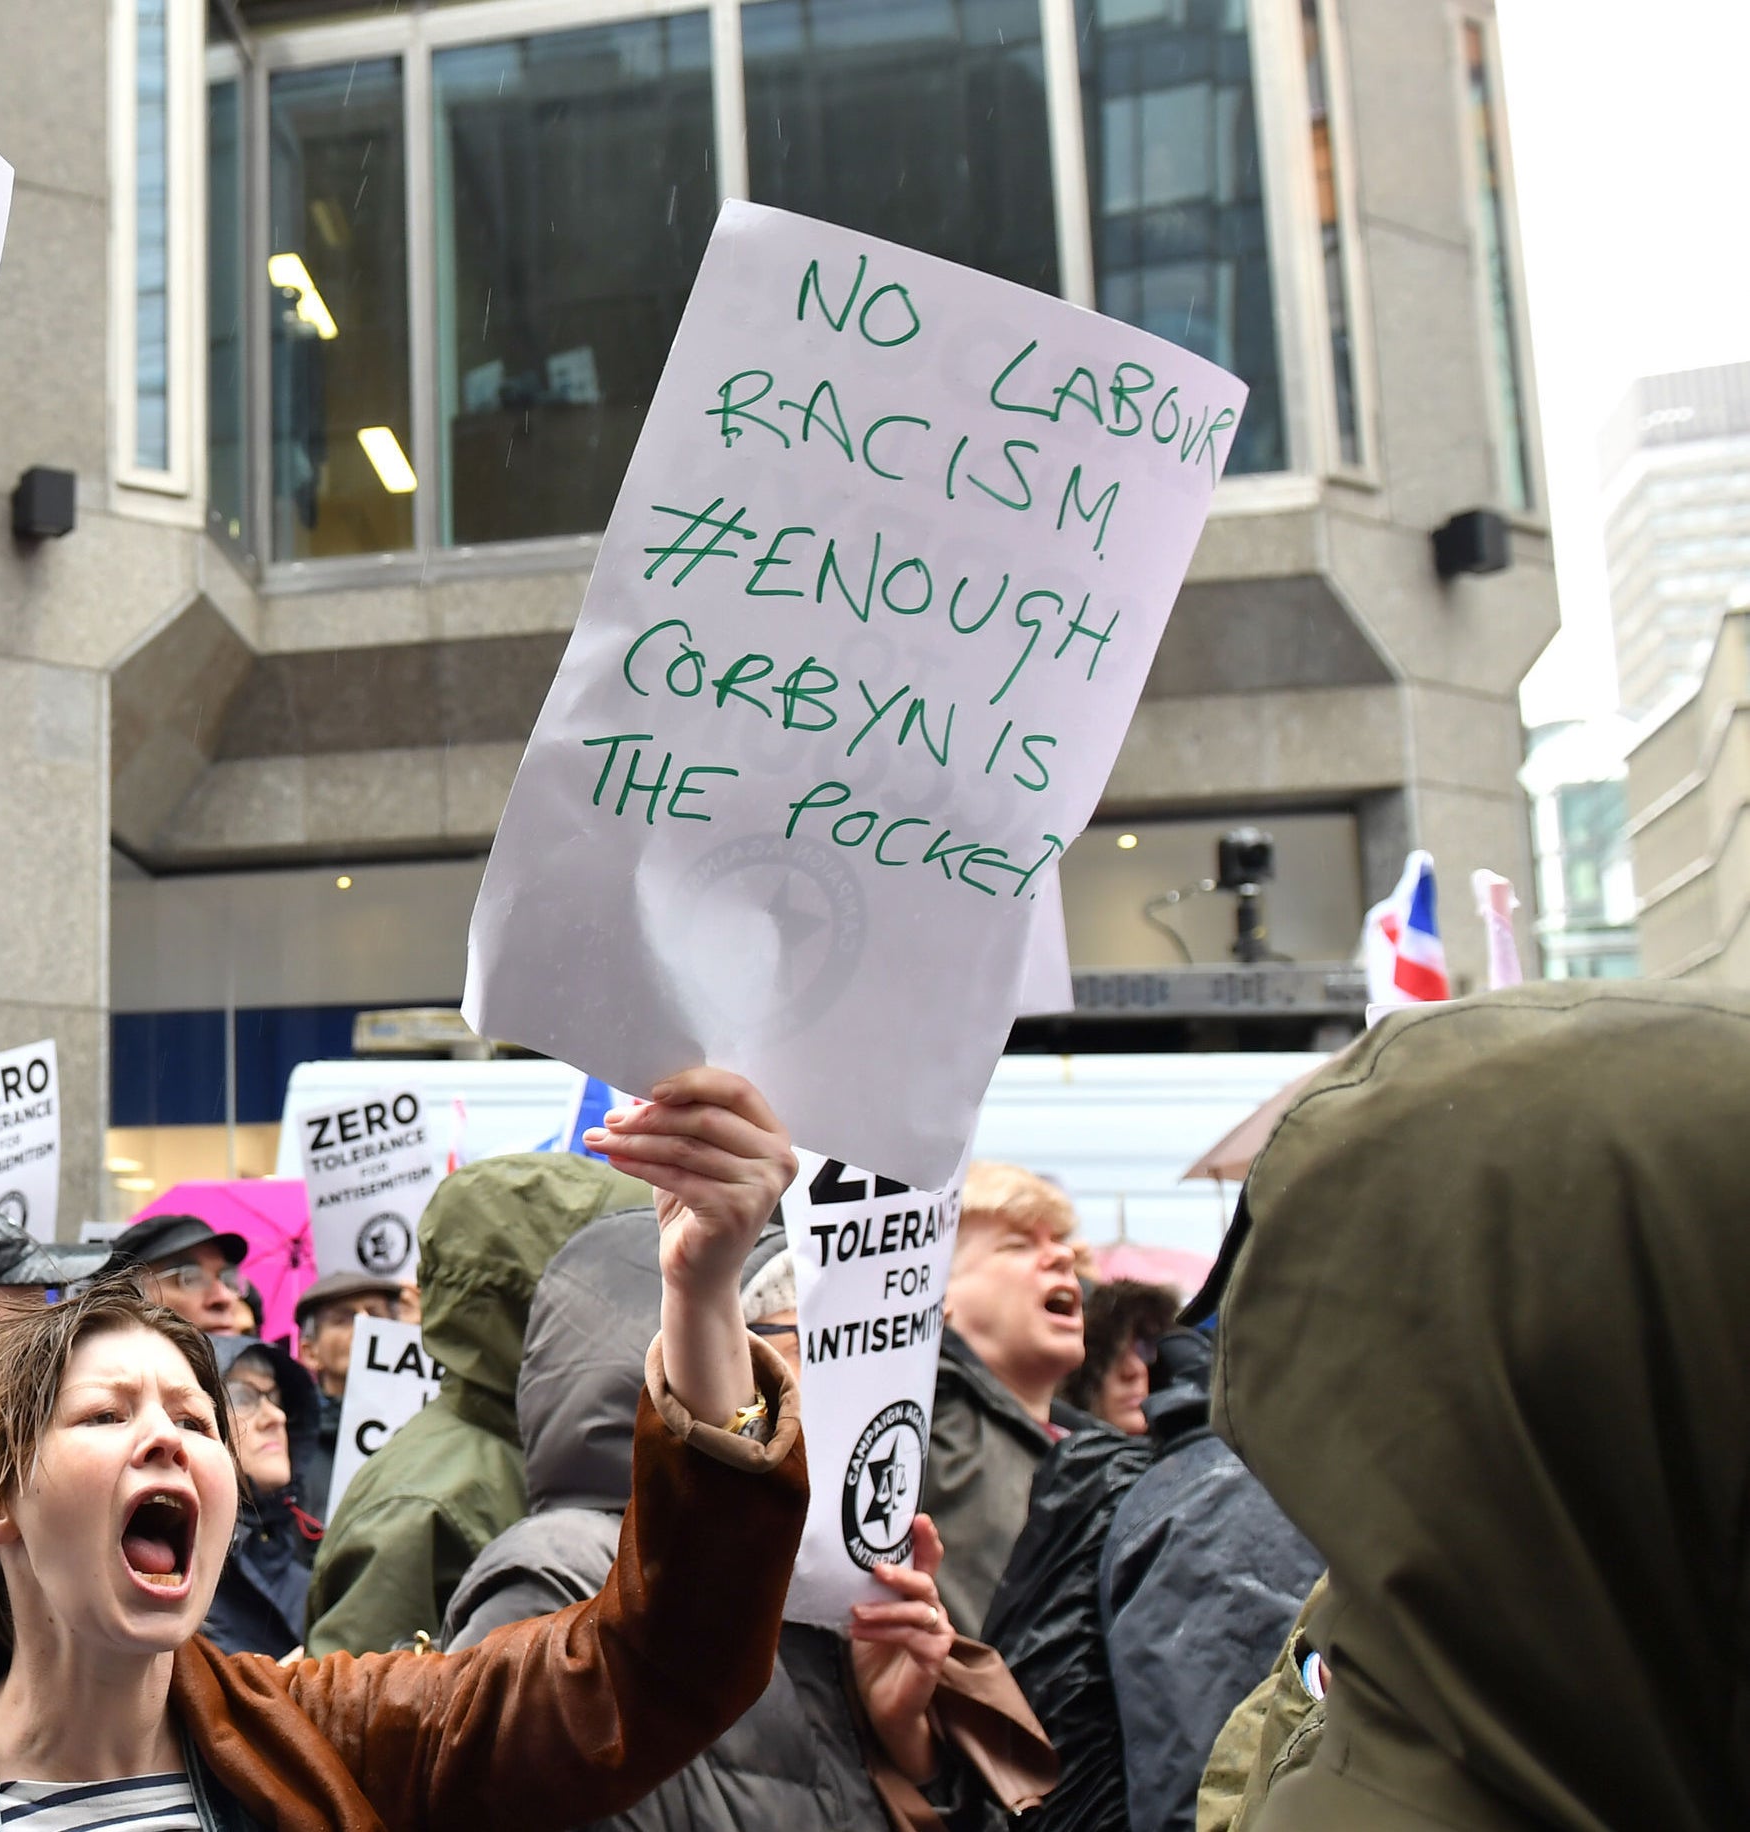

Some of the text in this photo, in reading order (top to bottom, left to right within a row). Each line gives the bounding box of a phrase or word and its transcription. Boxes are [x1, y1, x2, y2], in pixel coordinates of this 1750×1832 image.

[797, 254, 1235, 489] NO LABOUR
[645, 498, 1120, 703] #ENOUGH
[624, 620, 1058, 791] CORBYN IS
[584, 733, 739, 822] THE
[307, 1094, 418, 1151] ZERO
[311, 1129, 425, 1173] TOLERANCE
[884, 1264, 931, 1300] FOR
[847, 1405, 904, 1486] CAMPAIGN
